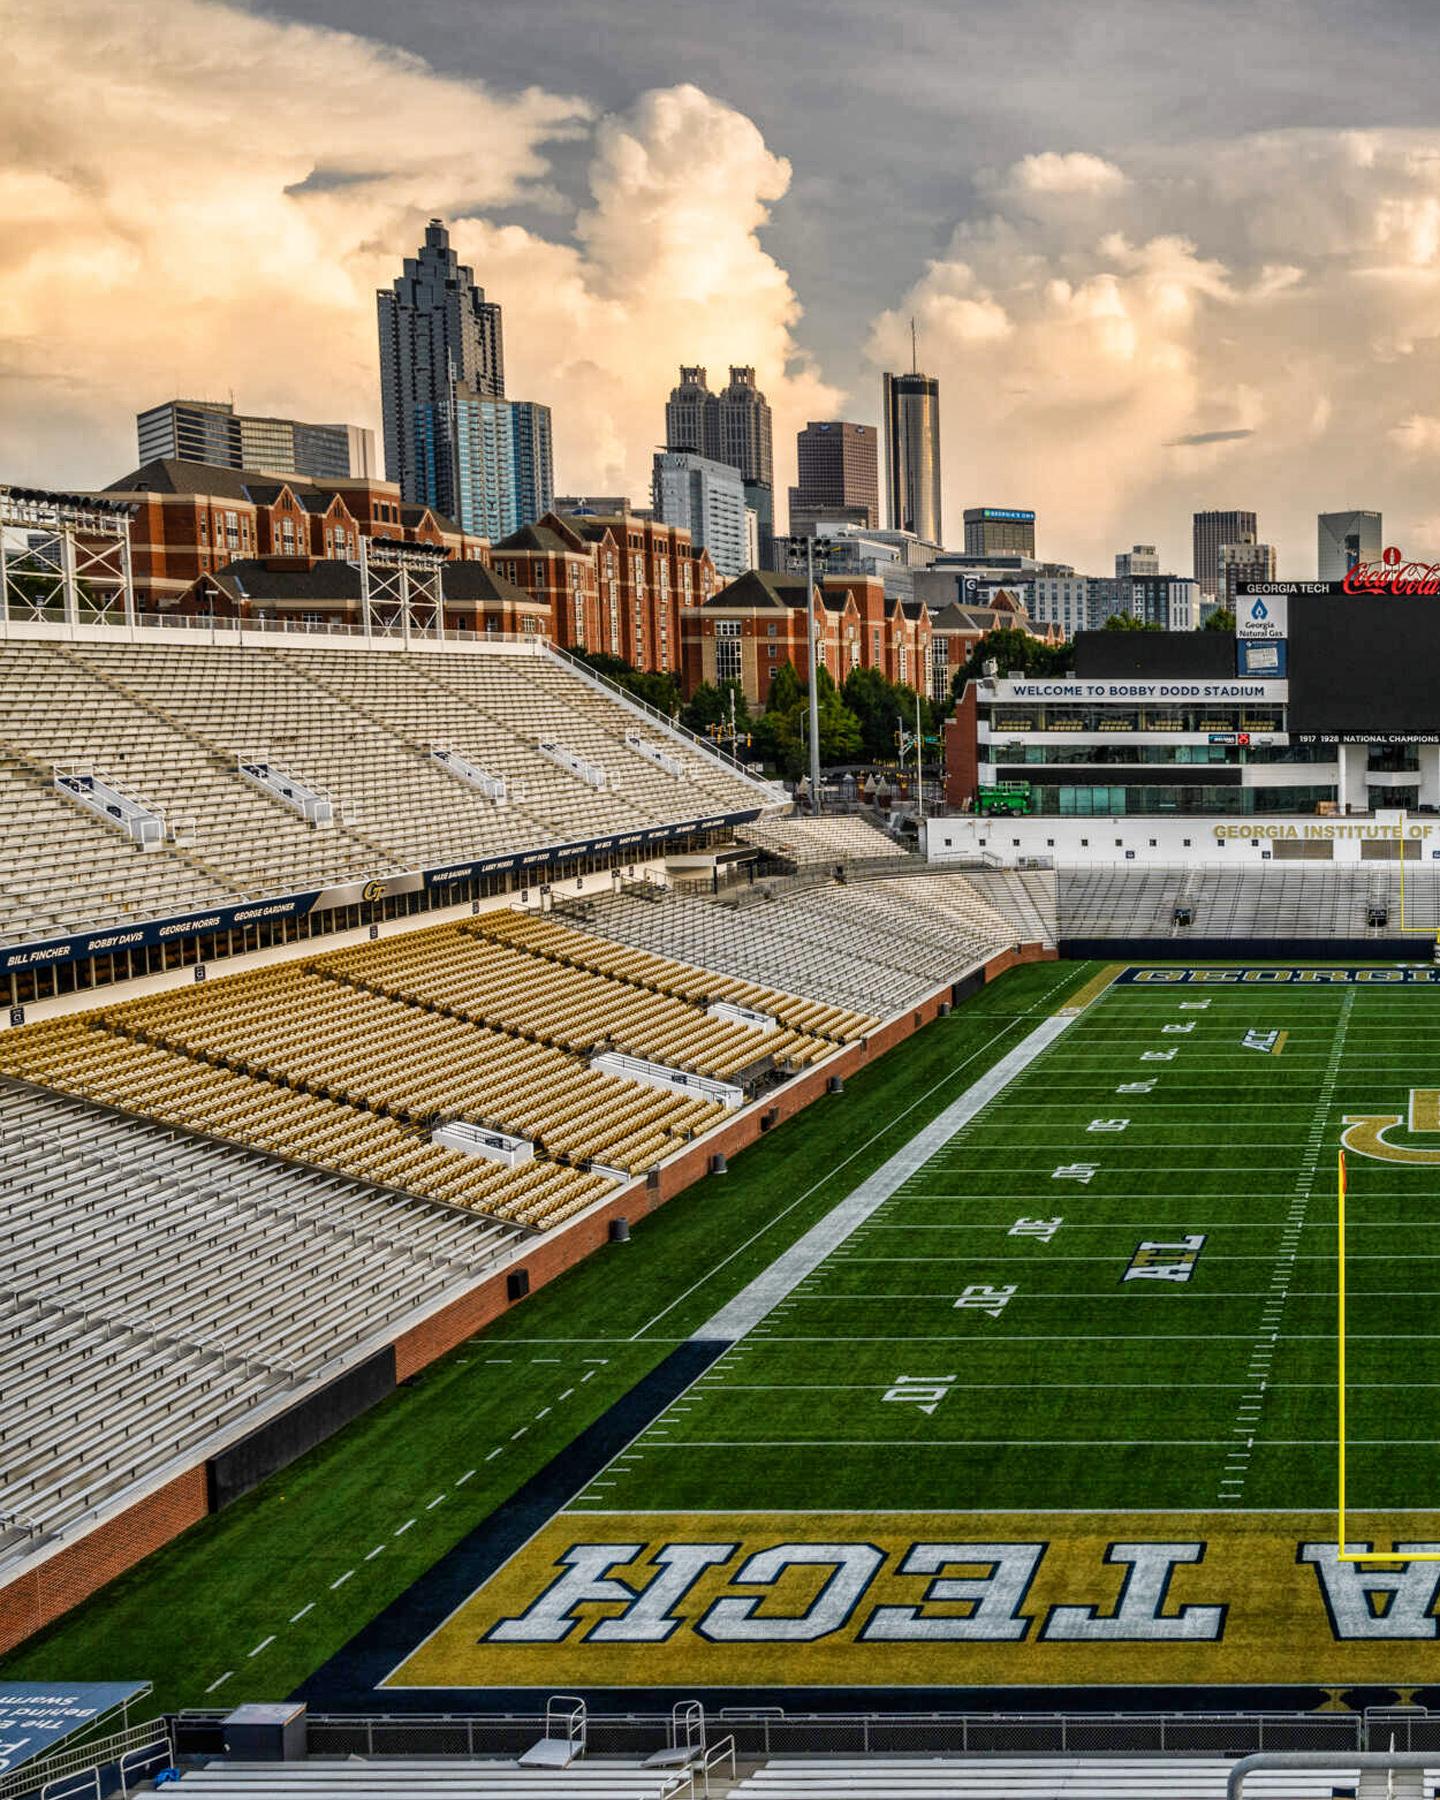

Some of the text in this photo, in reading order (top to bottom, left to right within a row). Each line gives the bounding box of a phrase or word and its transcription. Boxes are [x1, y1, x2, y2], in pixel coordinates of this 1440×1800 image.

[1247, 584, 1330, 594] GEORGIA TECH
[1245, 621, 1275, 630] Georgia
[1013, 686, 1265, 696] WELCOME TO BOBBY DODD STADIUM
[1300, 735, 1316, 743] 1917
[1320, 735, 1339, 743] 1928
[1343, 735, 1387, 743] NATIONAL
[1388, 735, 1440, 743] CHAMPIONS
[1213, 824, 1298, 839] GEORGIA
[1304, 824, 1402, 839] INSTITUTE
[1409, 824, 1433, 839] OF
[234, 908, 263, 921] GEORGE
[160, 917, 221, 936] GEORGE MORRIS
[88, 931, 145, 950] BOBBY DAVIS
[7, 945, 71, 966] BILL FINCHER
[1240, 1027, 1281, 1053] ACC
[1119, 1233, 1208, 1285] ATL
[477, 1541, 1231, 1643] TECH
[8, 1707, 97, 1717] Behind
[20, 1720, 64, 1729] The
